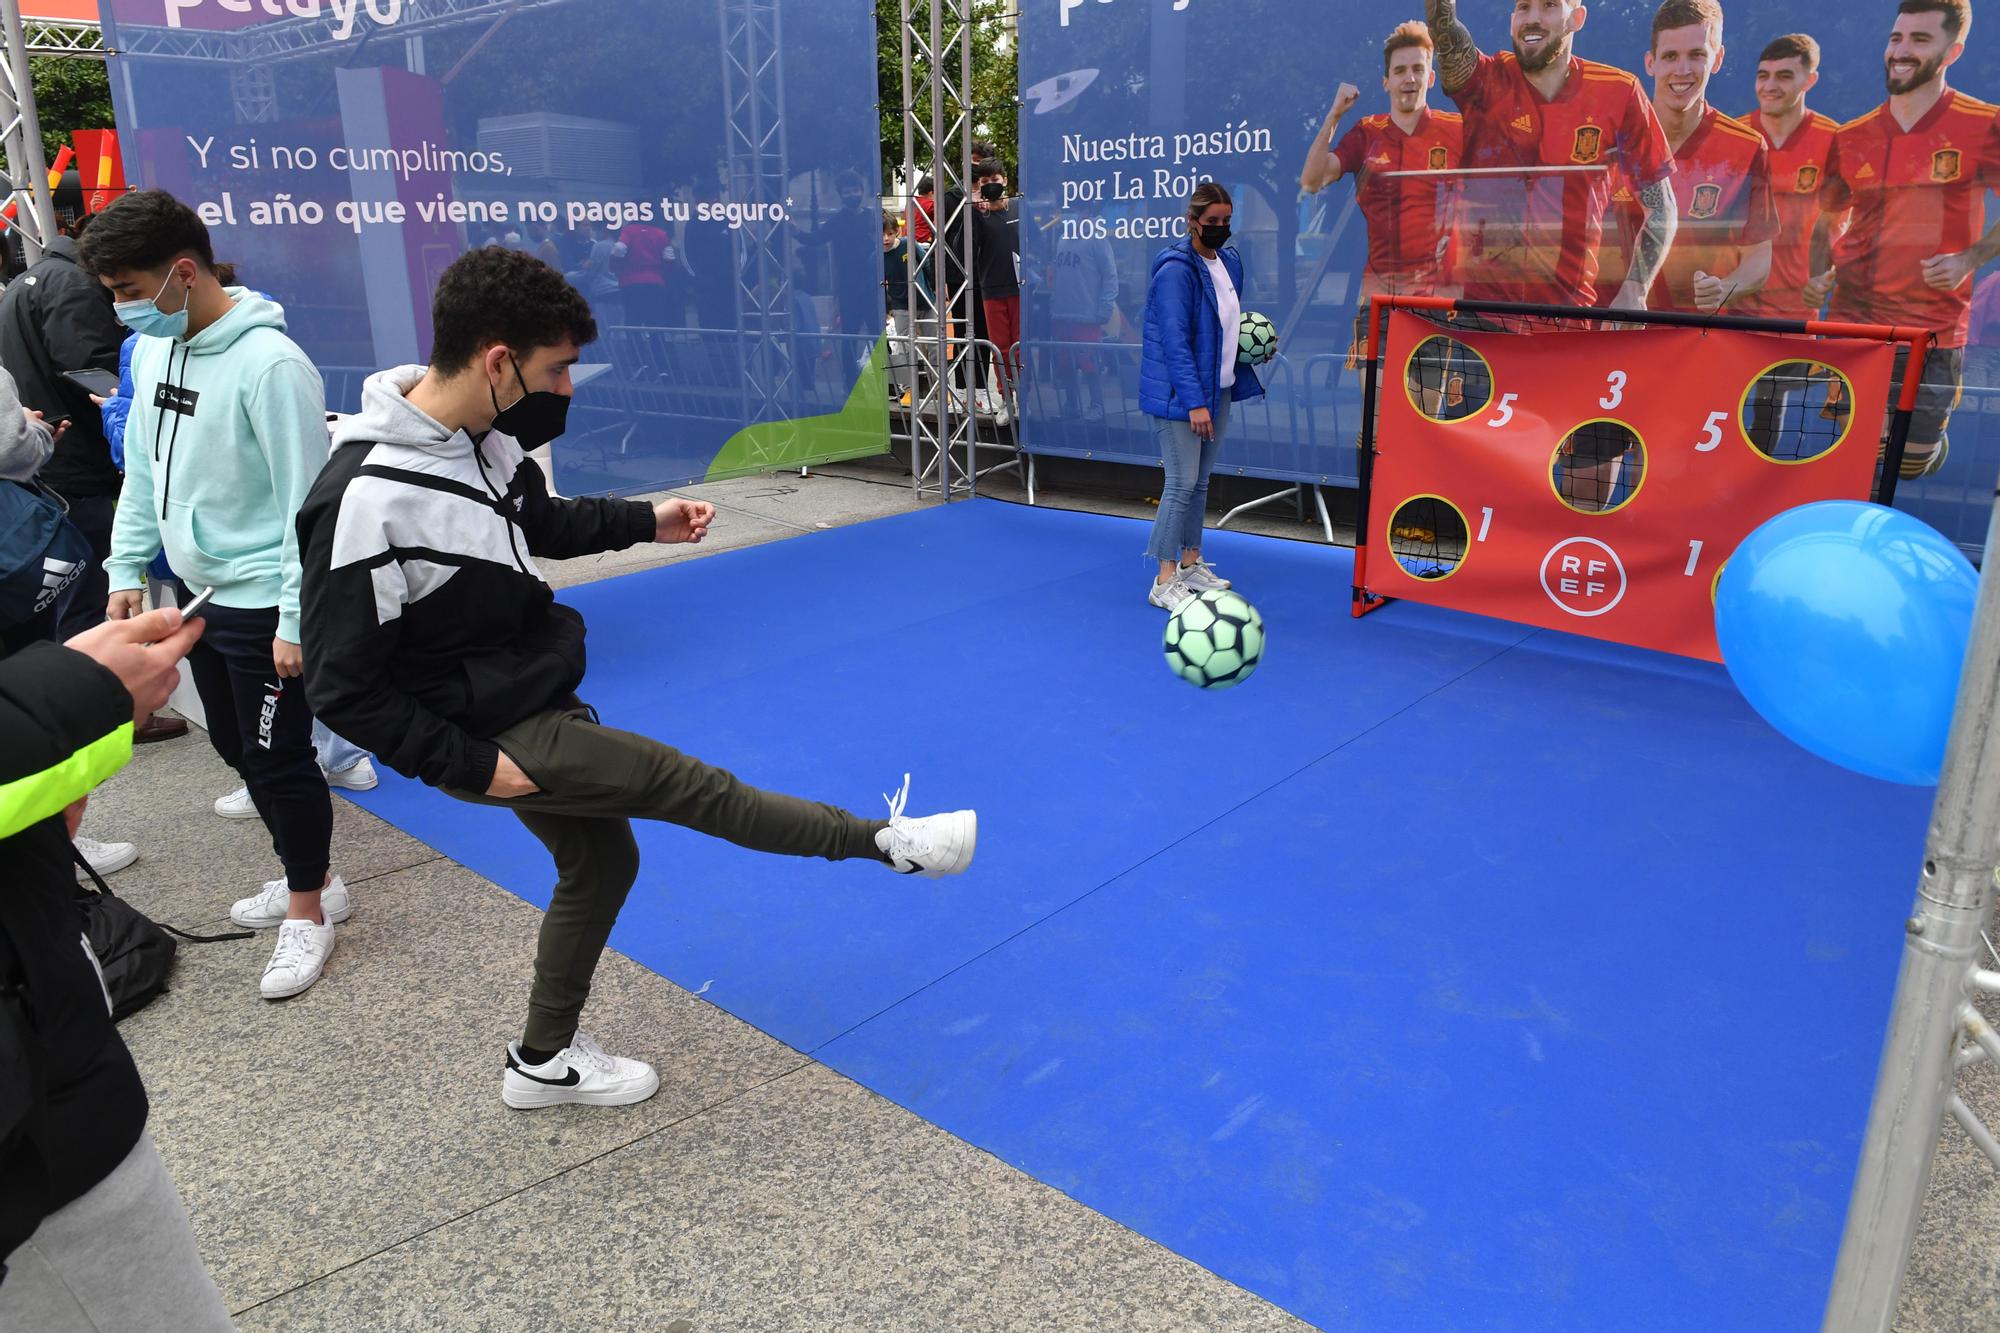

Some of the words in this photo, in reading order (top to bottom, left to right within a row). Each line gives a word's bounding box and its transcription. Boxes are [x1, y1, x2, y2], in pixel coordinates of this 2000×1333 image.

[186, 136, 215, 168] Y
[229, 138, 259, 169] si
[271, 146, 317, 170] no
[329, 141, 513, 181] cumplimos,
[1062, 132, 1166, 163] Nuestra
[1173, 120, 1272, 164] pasión
[1061, 179, 1106, 209] por
[1113, 171, 1145, 200] La
[197, 192, 237, 227] el
[250, 193, 324, 225] año
[335, 200, 406, 234] que
[416, 193, 508, 223] viene
[518, 201, 558, 222] no
[566, 201, 654, 231] pagas
[661, 198, 690, 221] tu
[1062, 217, 1107, 240] nos
[1114, 216, 1190, 239] acerc
[1599, 370, 1628, 410] 3
[1487, 393, 1519, 428] 5
[1694, 411, 1729, 452] 5
[1477, 506, 1494, 542] 1
[1684, 539, 1703, 576] 1
[34, 559, 86, 612] adidas
[258, 695, 278, 749] LEGEA
